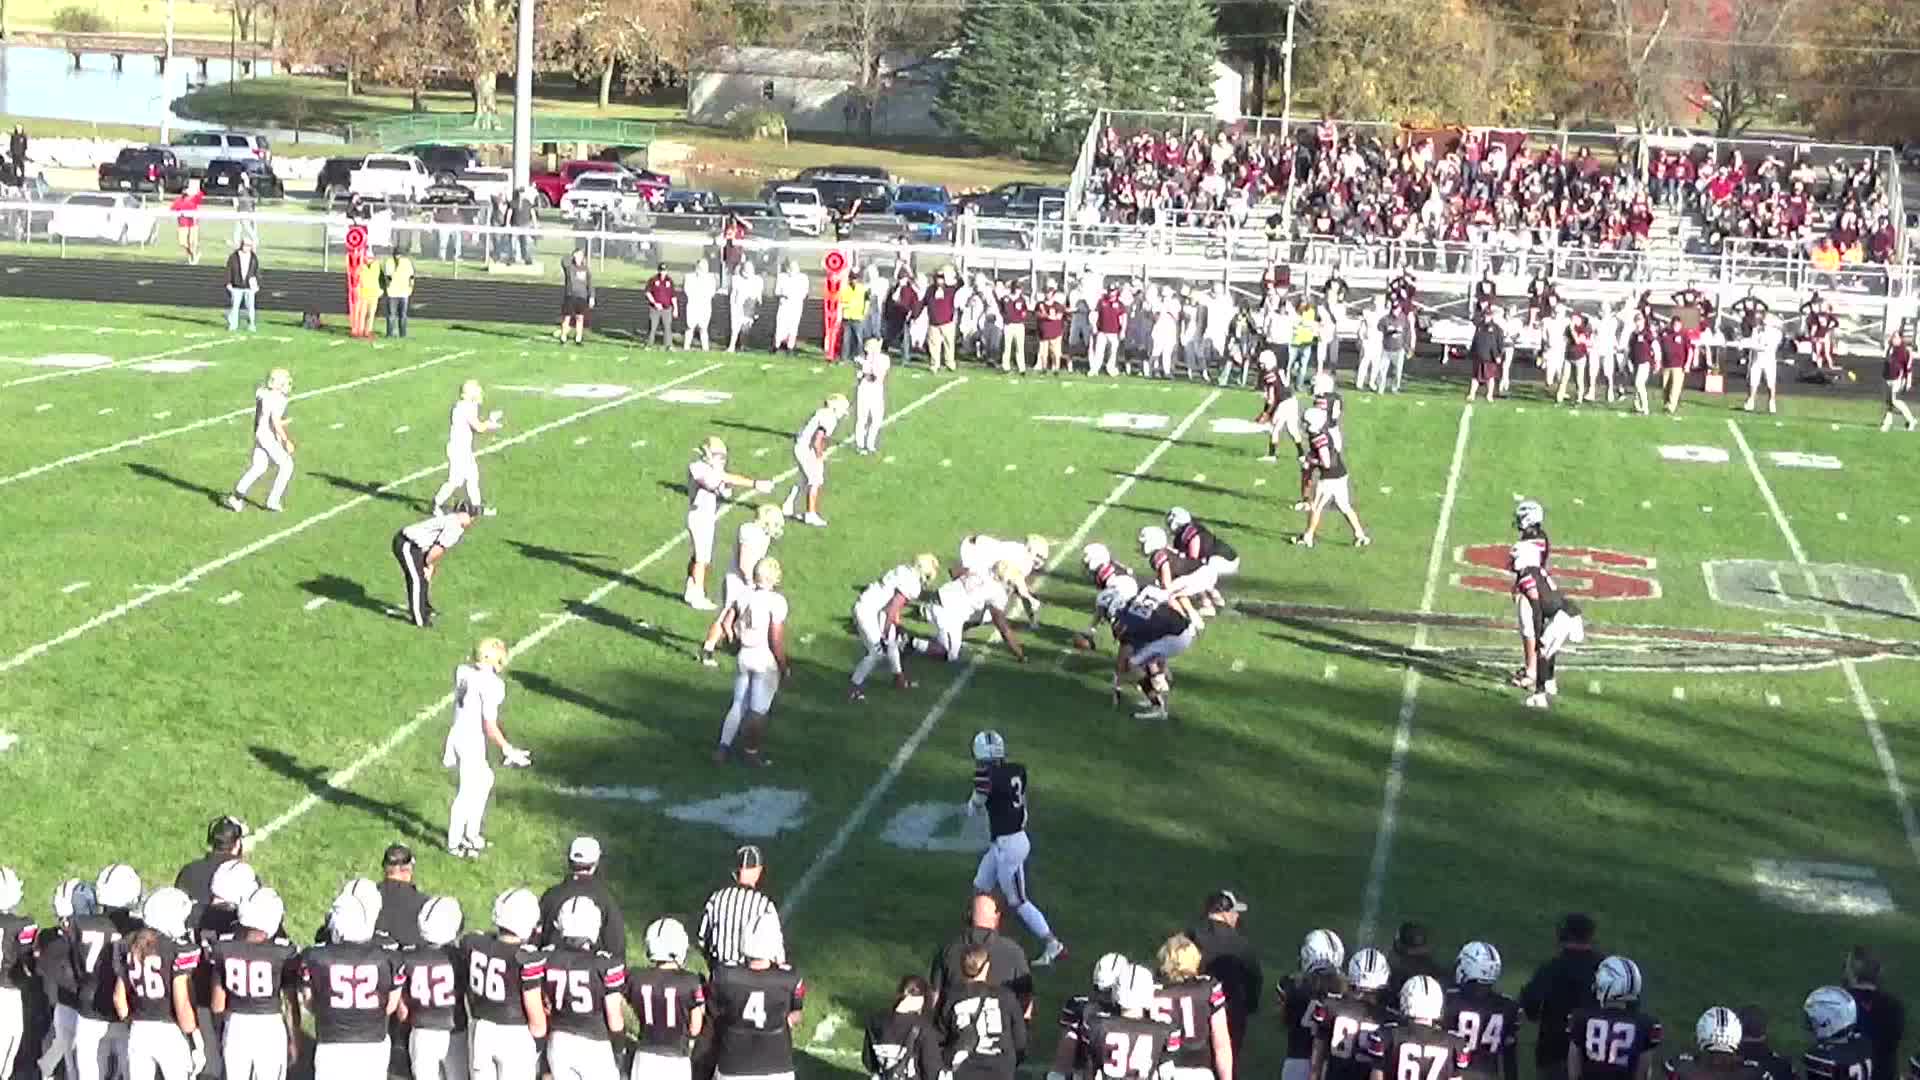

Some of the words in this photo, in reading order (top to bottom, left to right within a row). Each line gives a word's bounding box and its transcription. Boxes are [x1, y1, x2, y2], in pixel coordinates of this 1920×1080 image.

[1010, 776, 1022, 808] 3
[126, 951, 166, 999] 26
[225, 957, 273, 998] 88
[329, 964, 380, 1009] 52
[410, 964, 456, 1007] 42
[469, 950, 506, 1002] 66
[546, 968, 594, 1014] 75
[640, 984, 678, 1028] 11
[742, 991, 767, 1030] 4
[1103, 1032, 1153, 1079] 34
[1398, 1042, 1449, 1080] 67
[1585, 1018, 1636, 1065] 82
